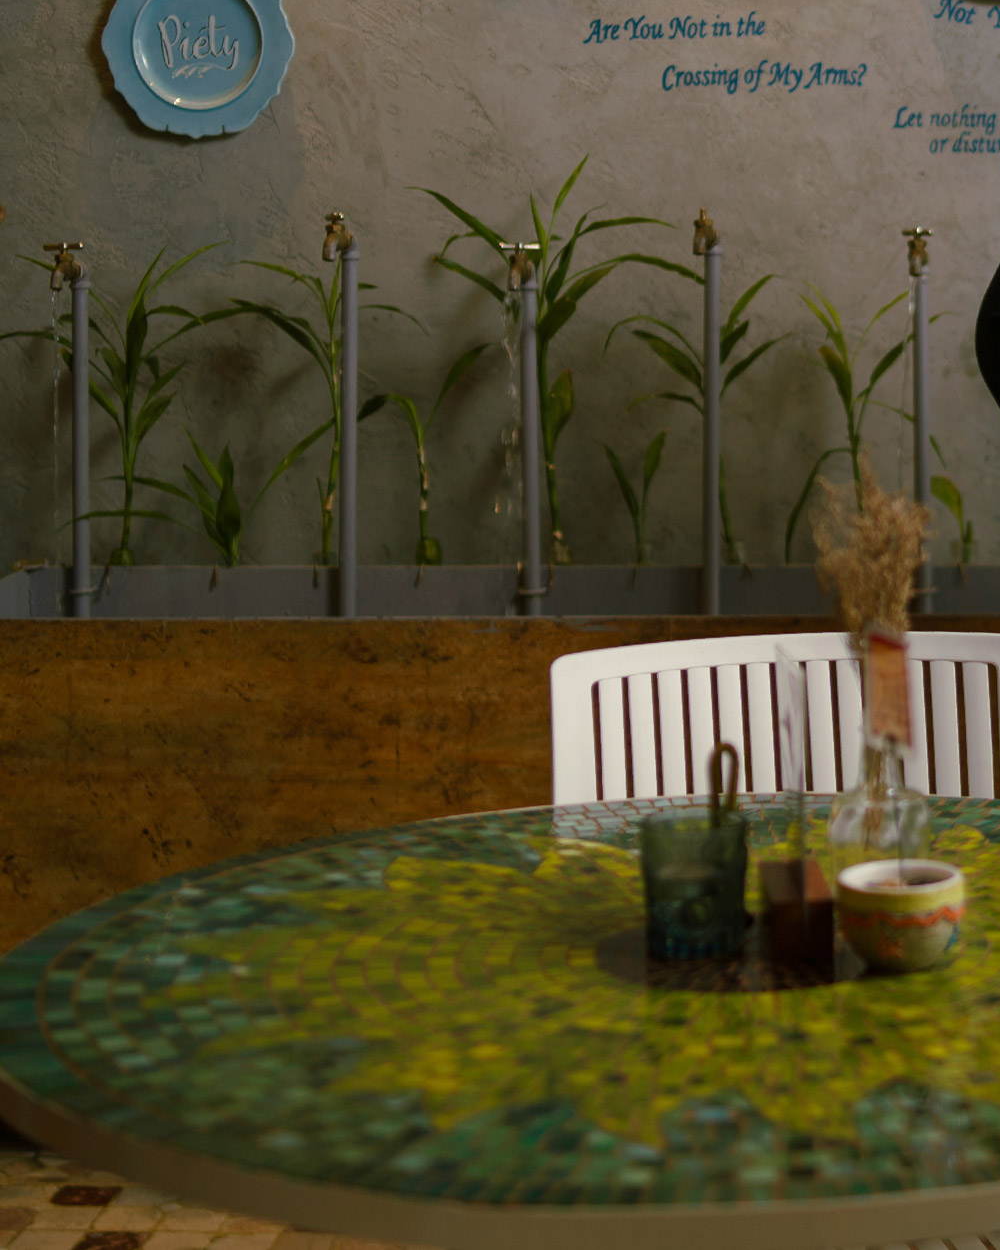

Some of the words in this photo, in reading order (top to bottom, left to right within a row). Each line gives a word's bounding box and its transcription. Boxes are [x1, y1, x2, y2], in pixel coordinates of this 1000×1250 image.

[157, 14, 239, 71] Piety
[583, 18, 620, 44] Are
[623, 15, 664, 40] You
[668, 16, 708, 39] Not
[712, 14, 732, 37] in
[736, 11, 766, 37] the
[661, 63, 739, 95] Crossing
[743, 59, 769, 93] of
[767, 62, 803, 93] My
[803, 61, 868, 89] Arms?
[892, 106, 923, 129] Let
[930, 103, 997, 135] nothing
[929, 138, 948, 154] or
